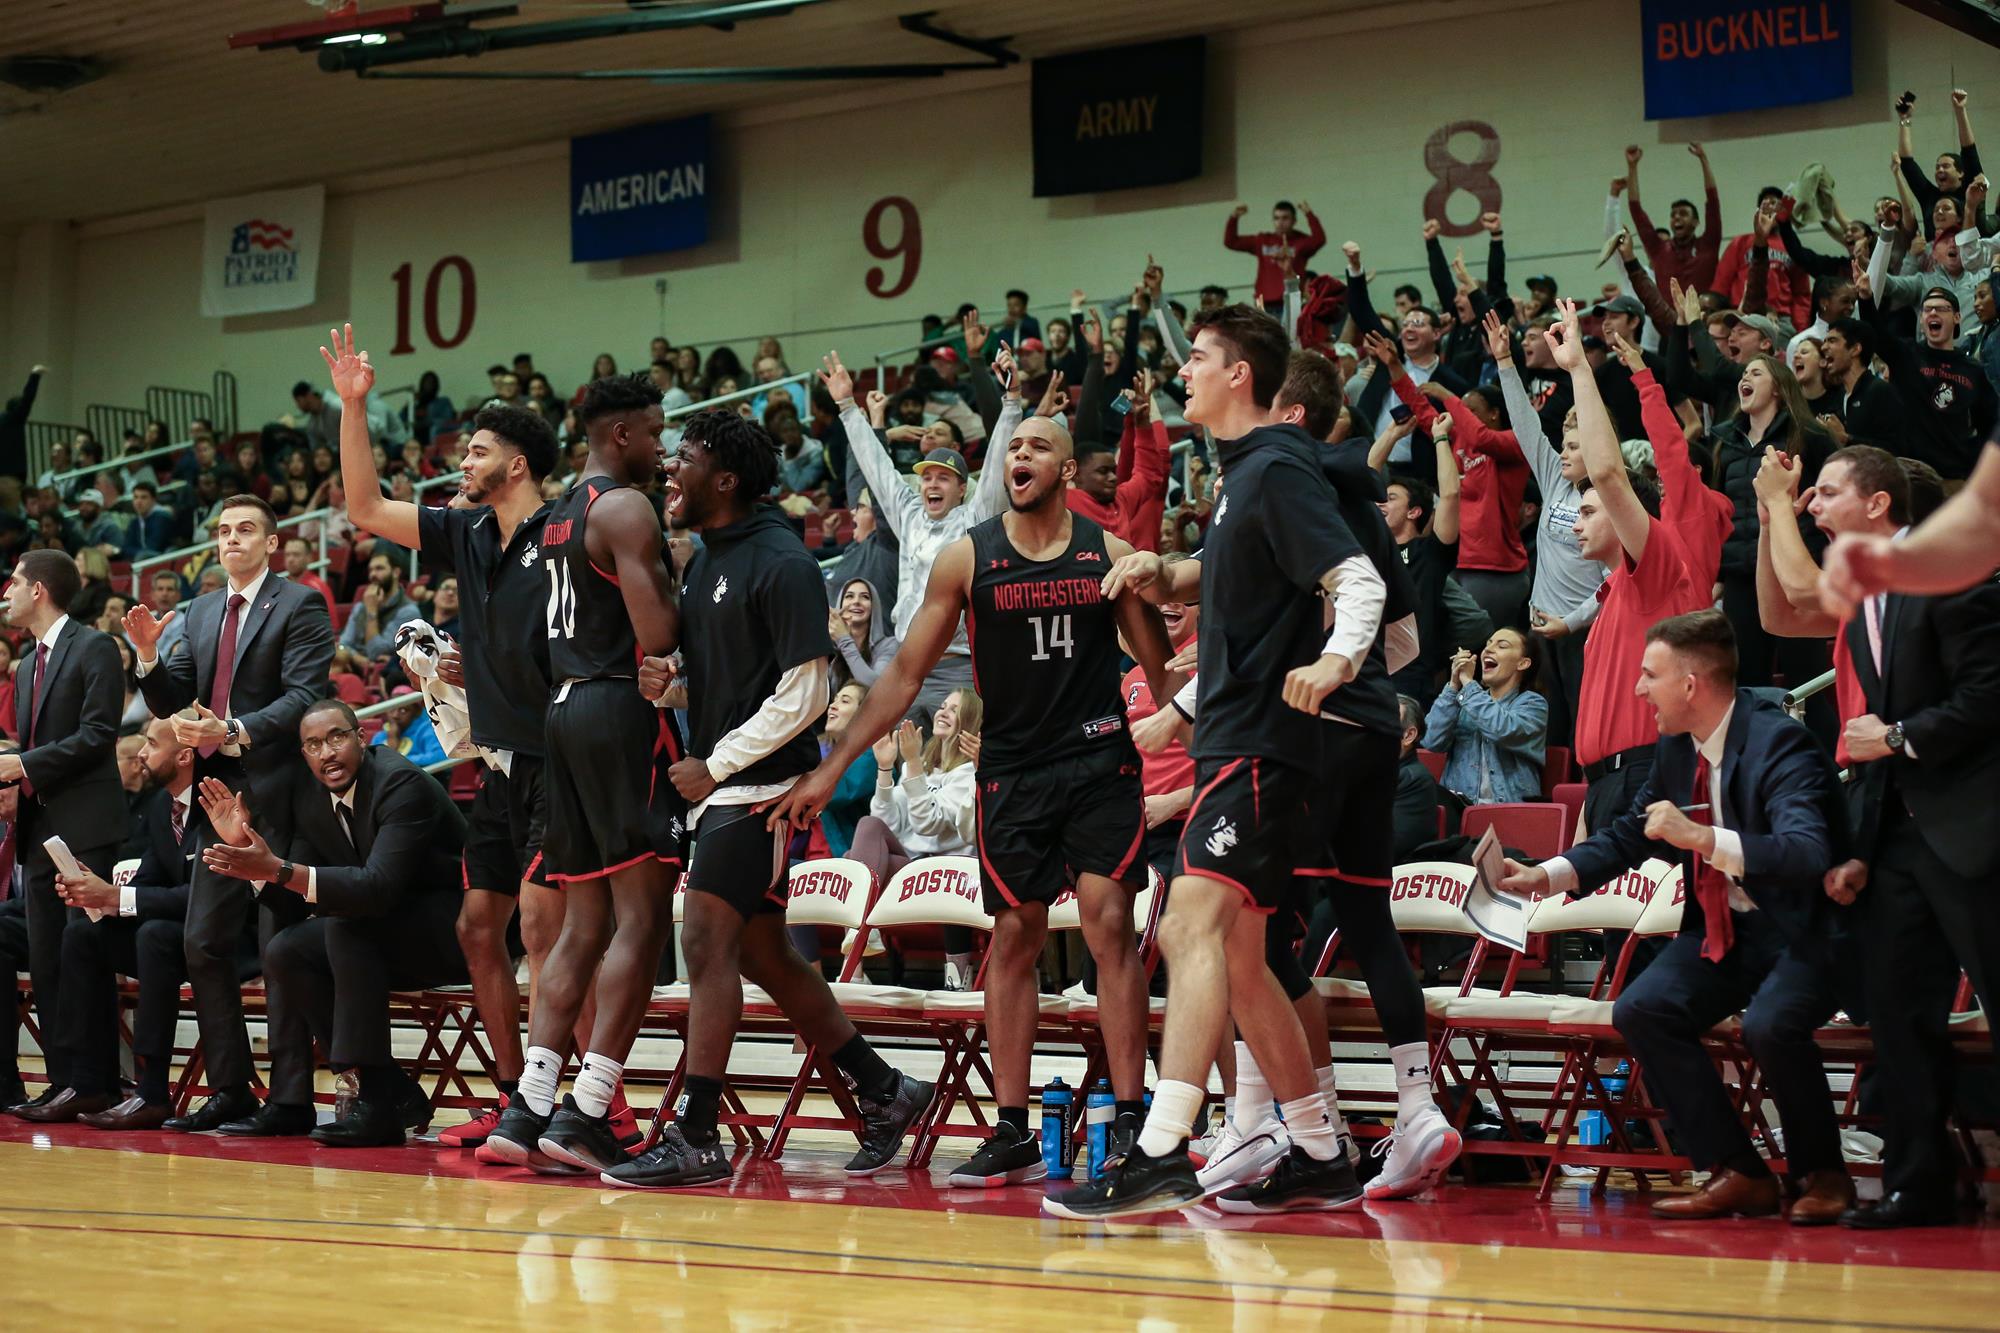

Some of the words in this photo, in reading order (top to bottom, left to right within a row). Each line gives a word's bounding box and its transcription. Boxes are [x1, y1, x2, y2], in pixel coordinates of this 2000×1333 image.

[1656, 3, 1839, 60] BUCKNELL
[1075, 95, 1158, 141] ARMY
[577, 163, 705, 216] AMERICAN
[1423, 120, 1503, 238] 8
[224, 250, 298, 271] PATRIOT
[862, 195, 922, 299] 9
[389, 255, 477, 356] 10
[1075, 551, 1100, 562] CAA
[545, 556, 576, 640] 20
[994, 578, 1100, 611] NORTHEASTERN
[1028, 614, 1074, 661] 14
[898, 869, 979, 904] BOSTON
[1391, 874, 1468, 908] OSTON
